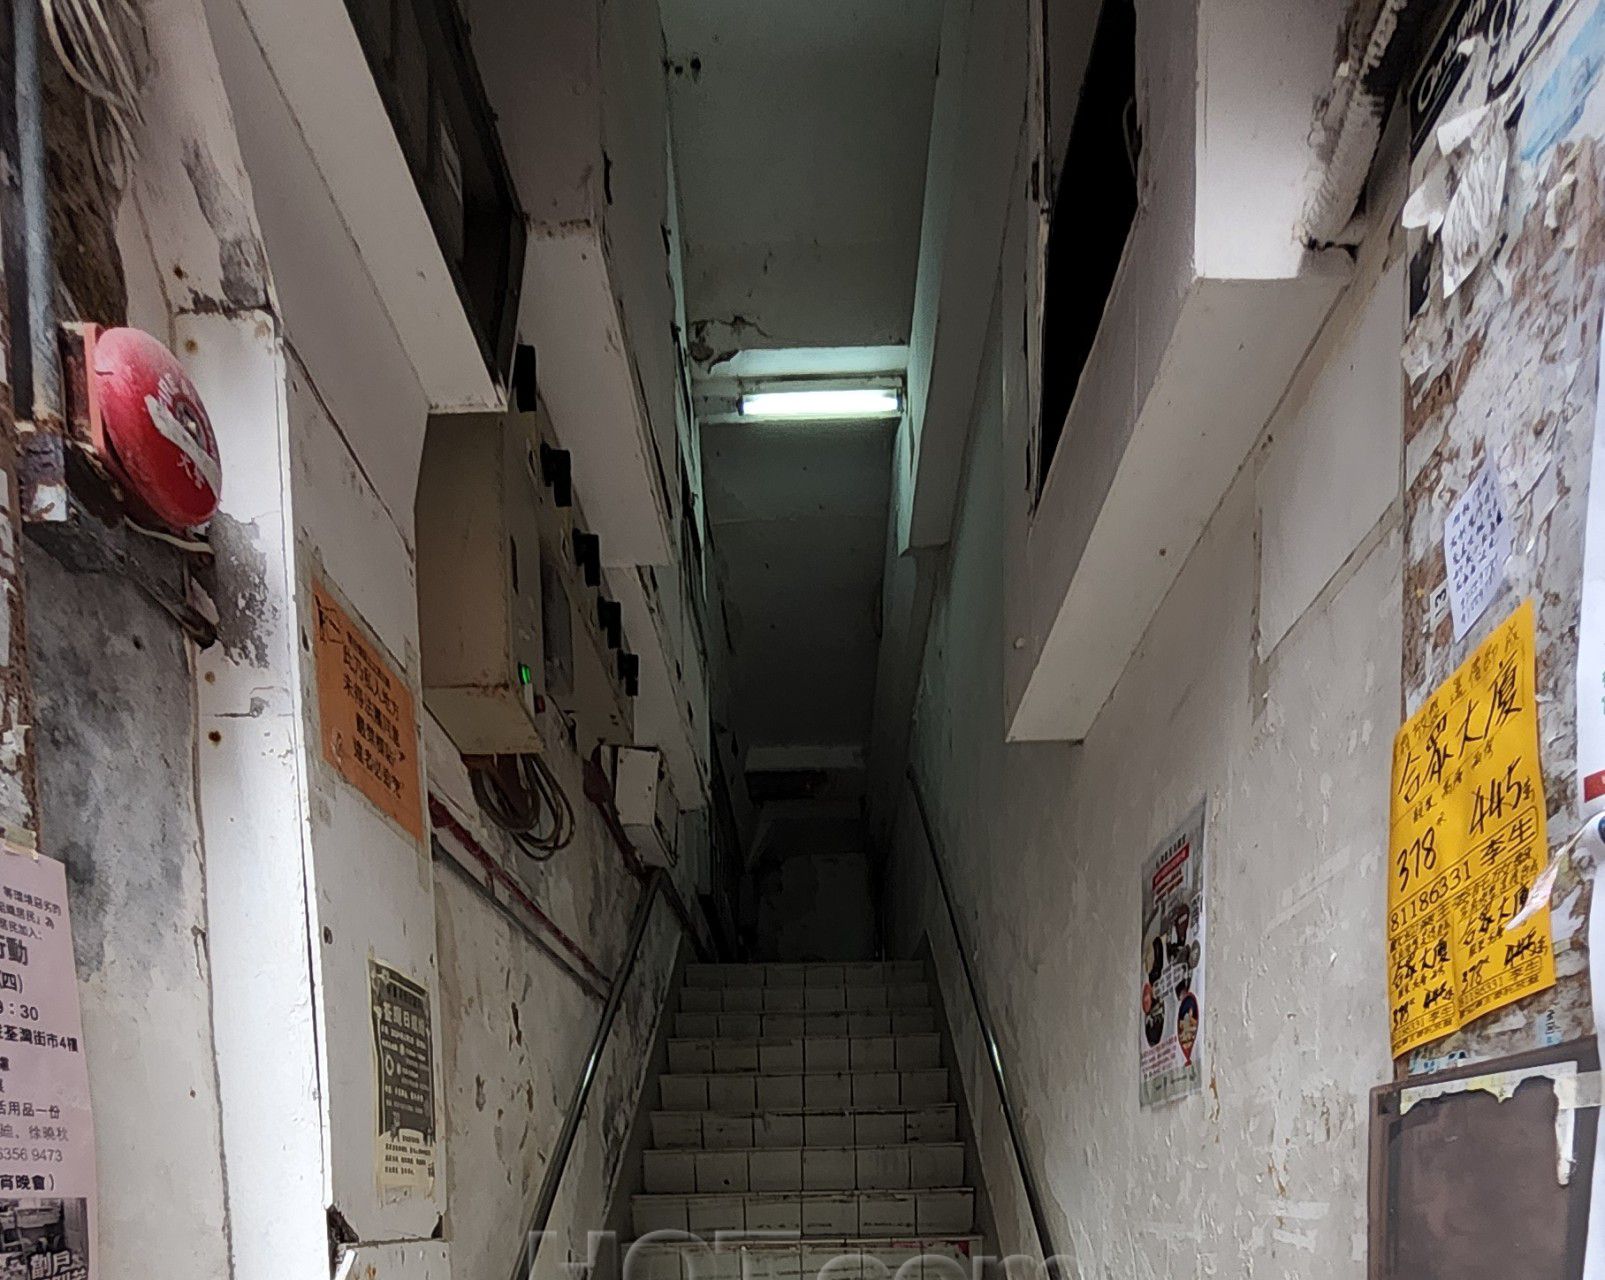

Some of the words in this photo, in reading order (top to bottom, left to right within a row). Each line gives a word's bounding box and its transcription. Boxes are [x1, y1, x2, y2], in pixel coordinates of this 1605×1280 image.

[1391, 859, 1471, 932] 81186331
[1480, 818, 1536, 866] 李生
[0, 1024, 78, 1052] 荃灣街市4樓
[32, 1149, 63, 1162] 9473
